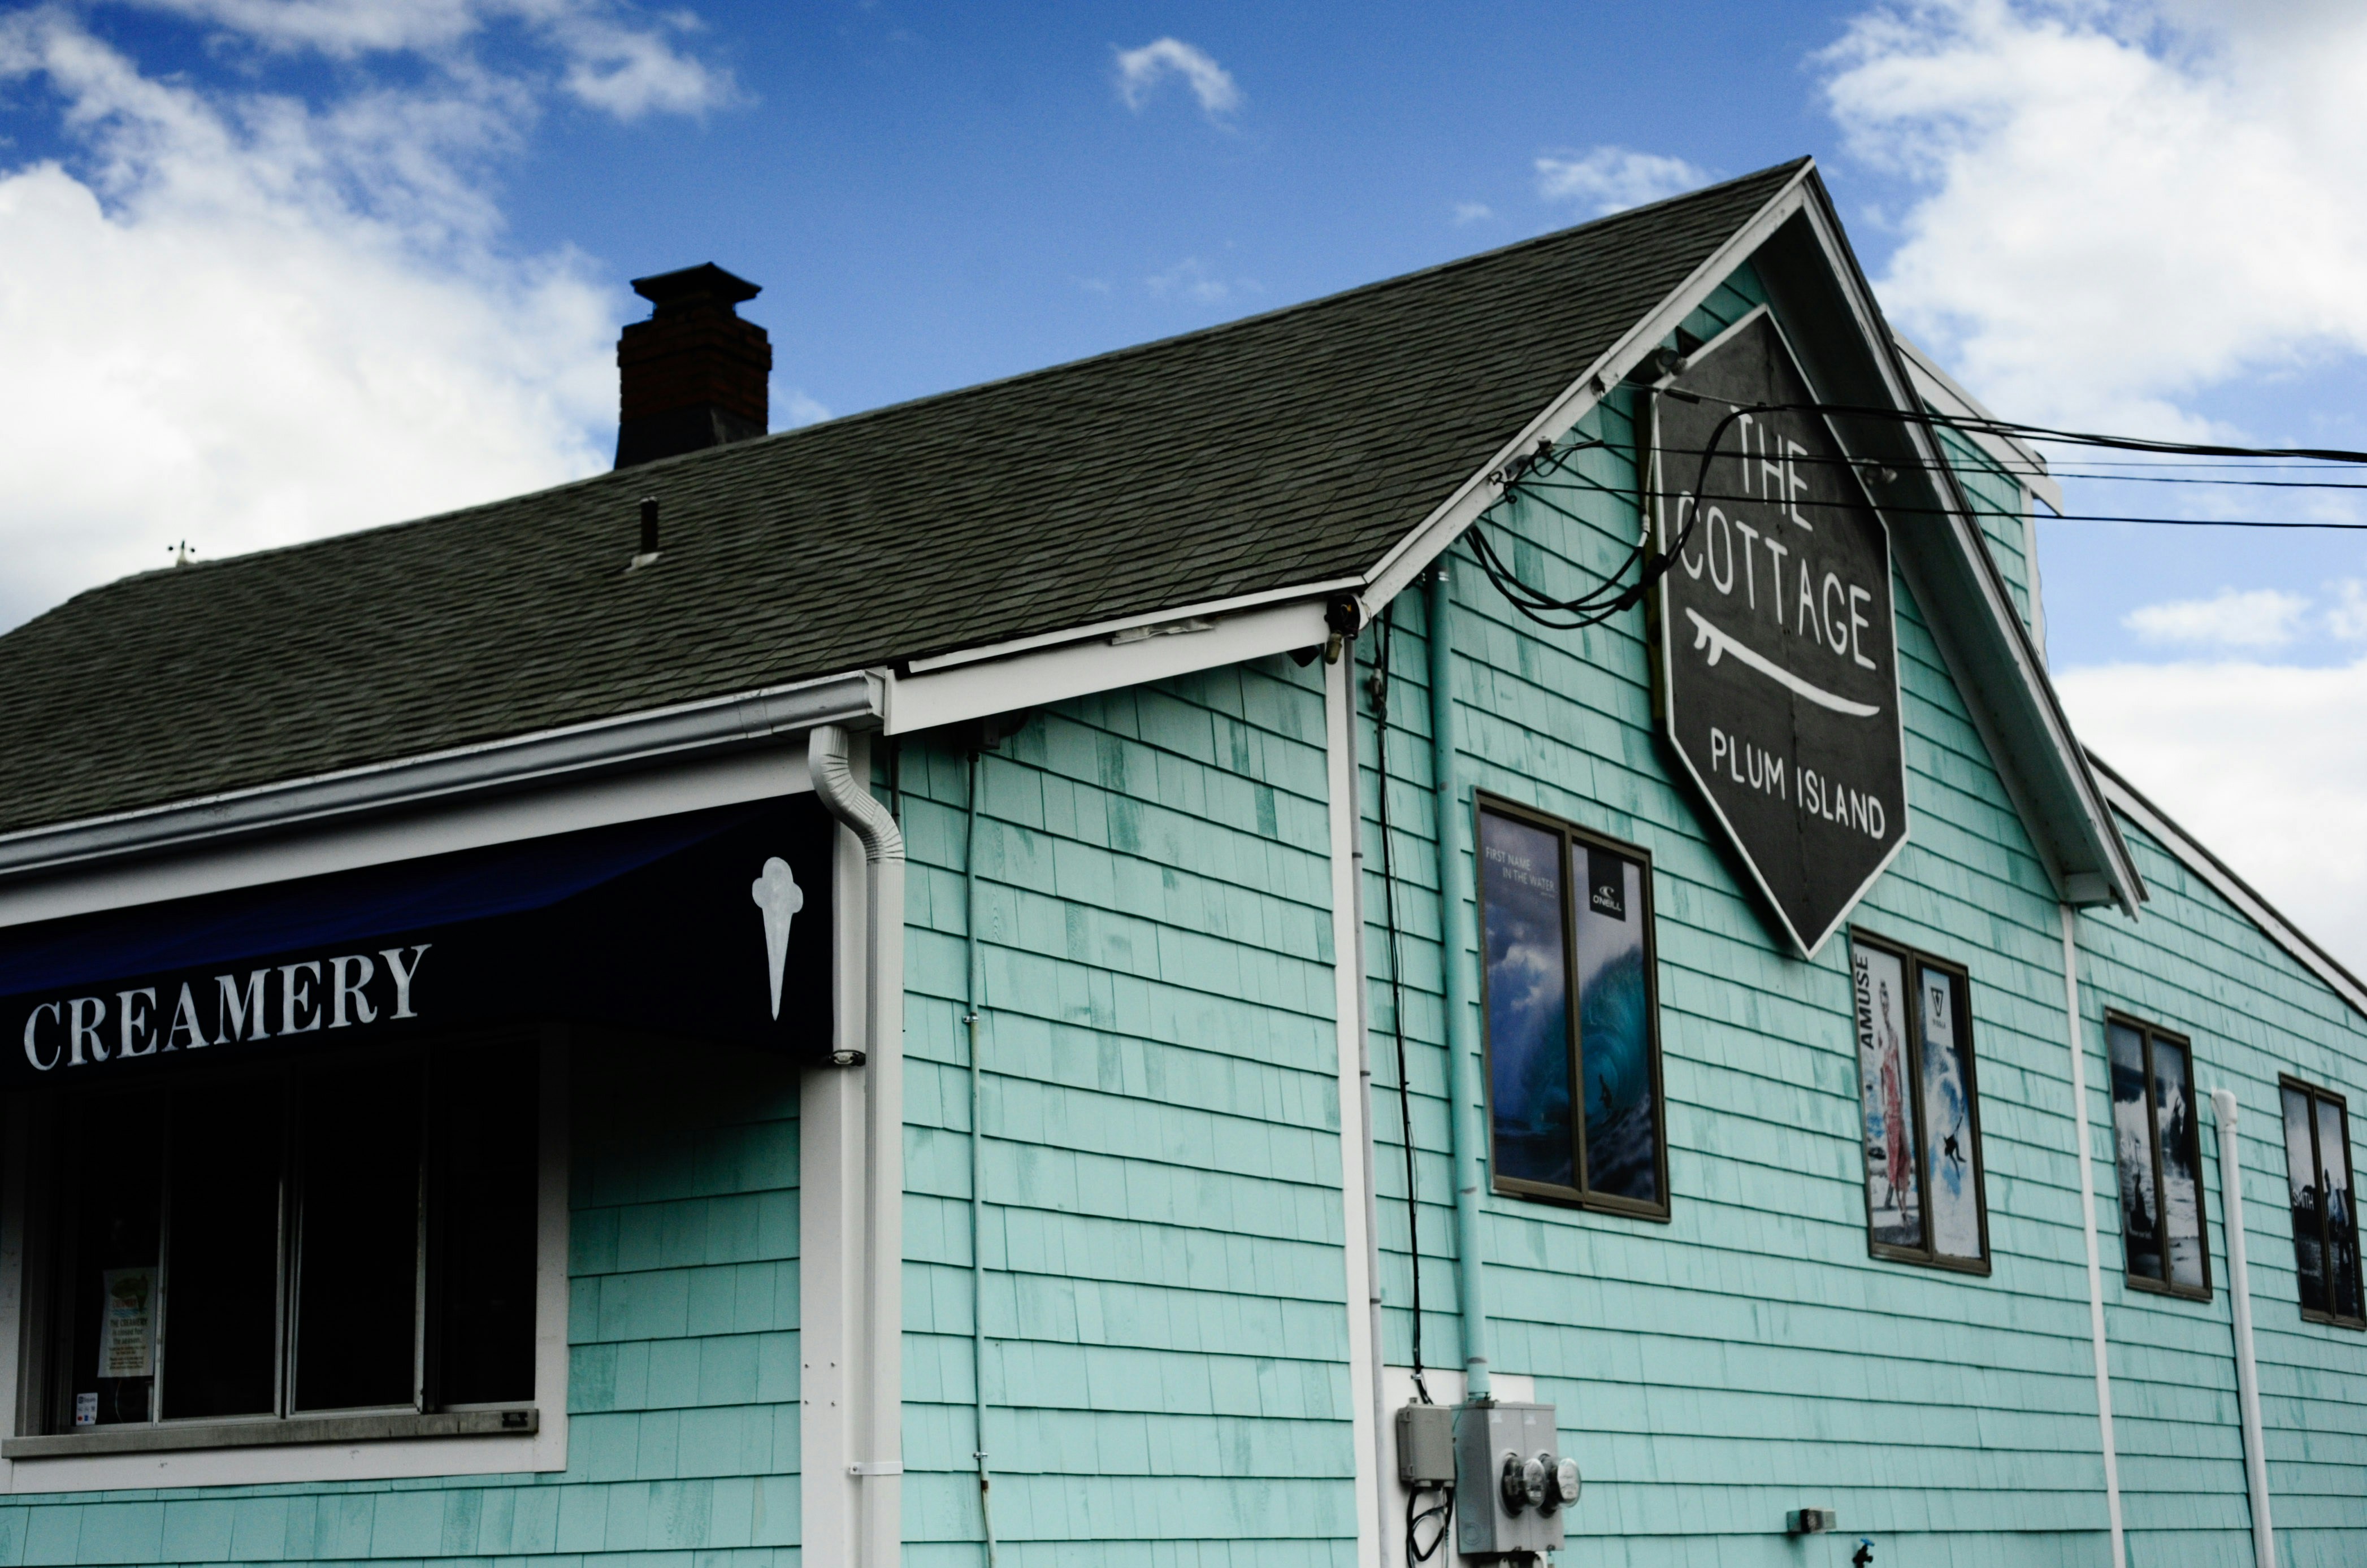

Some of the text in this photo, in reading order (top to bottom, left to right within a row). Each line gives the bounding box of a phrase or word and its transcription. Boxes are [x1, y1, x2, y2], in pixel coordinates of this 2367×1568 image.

[1730, 405, 1813, 532] THE
[1677, 490, 1876, 671] COTTAGE
[1711, 727, 1885, 840] PLUM ISLAND
[1486, 847, 1531, 871] FIRST NAME
[1502, 867, 1511, 879] IN
[1513, 870, 1528, 885] THE
[24, 944, 432, 1071] CREAMERY
[1856, 954, 1874, 1050] AMUSE
[2292, 1189, 2314, 1210] SMITH
